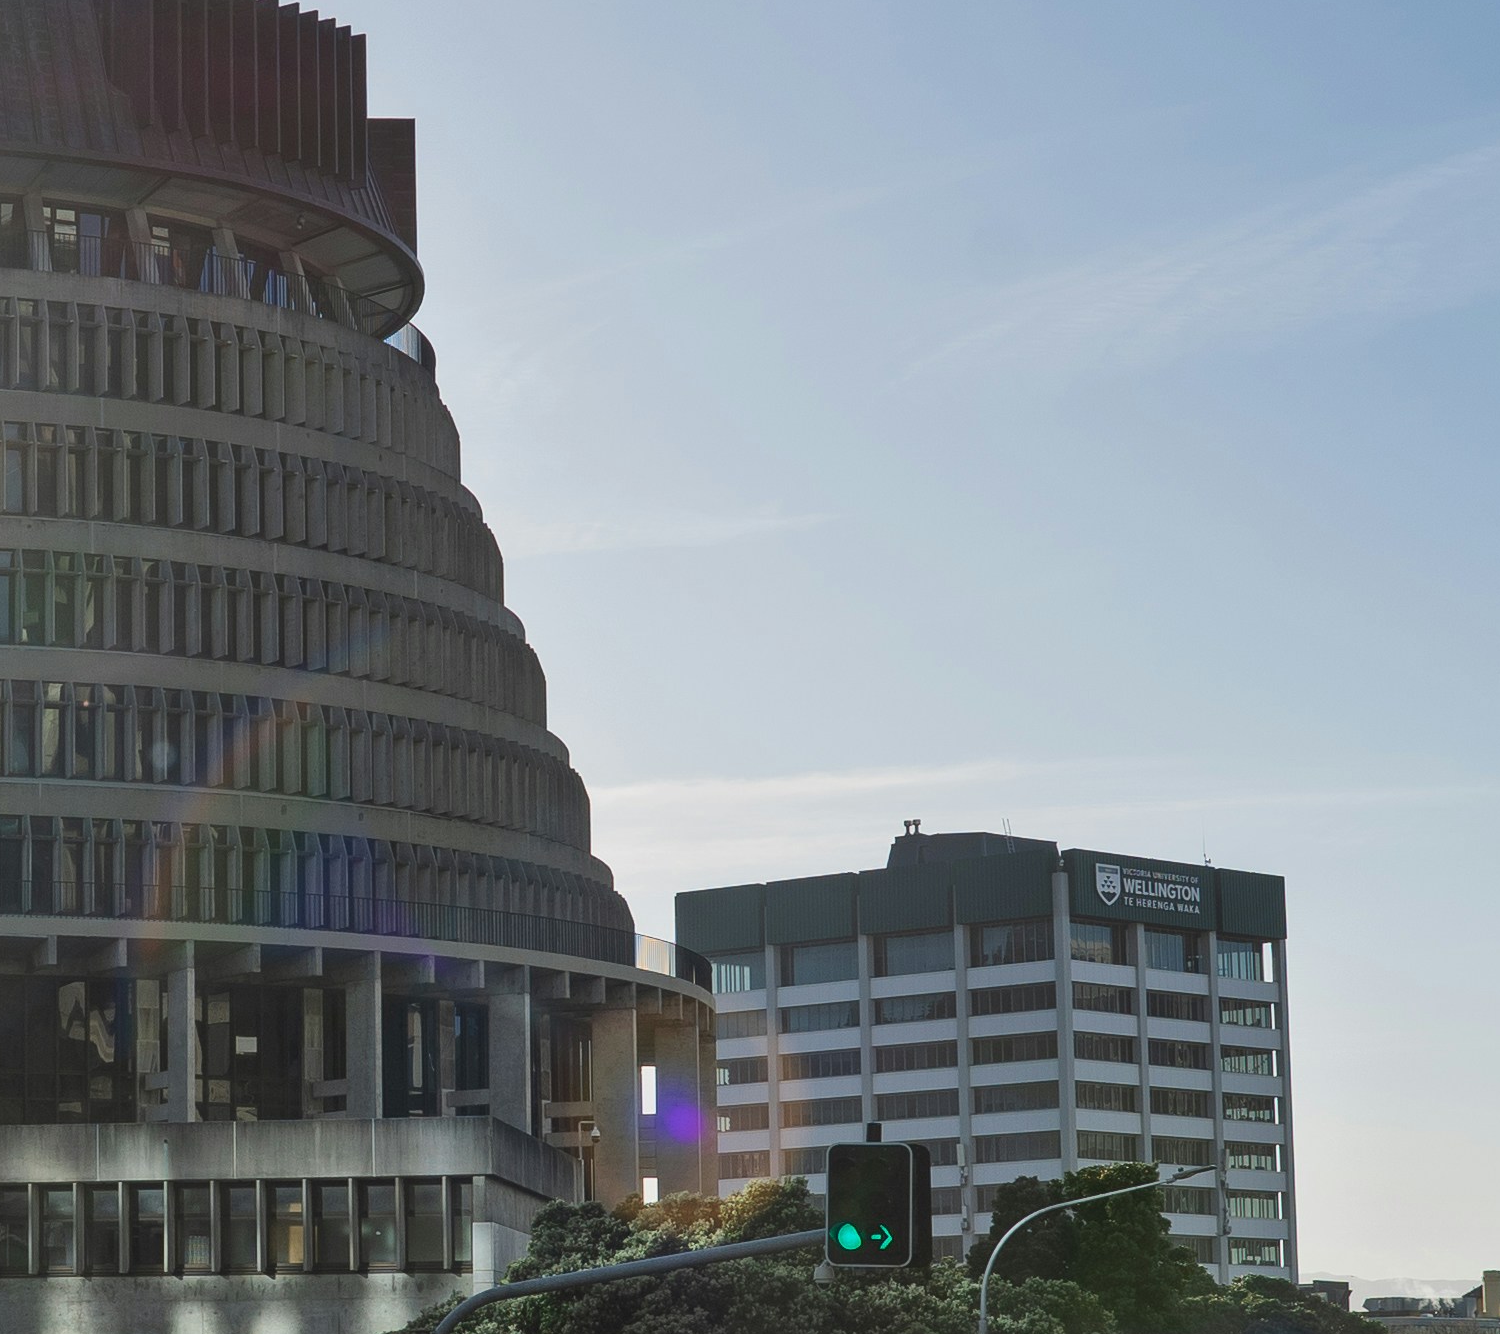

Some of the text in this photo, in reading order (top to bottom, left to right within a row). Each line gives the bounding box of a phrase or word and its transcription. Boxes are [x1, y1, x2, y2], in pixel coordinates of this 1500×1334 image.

[1121, 867, 1199, 884] VICTORIA UNIVERSITY OF
[1122, 877, 1200, 903] WELLINGTON
[1123, 896, 1200, 914] TE HERENGA WAKA
